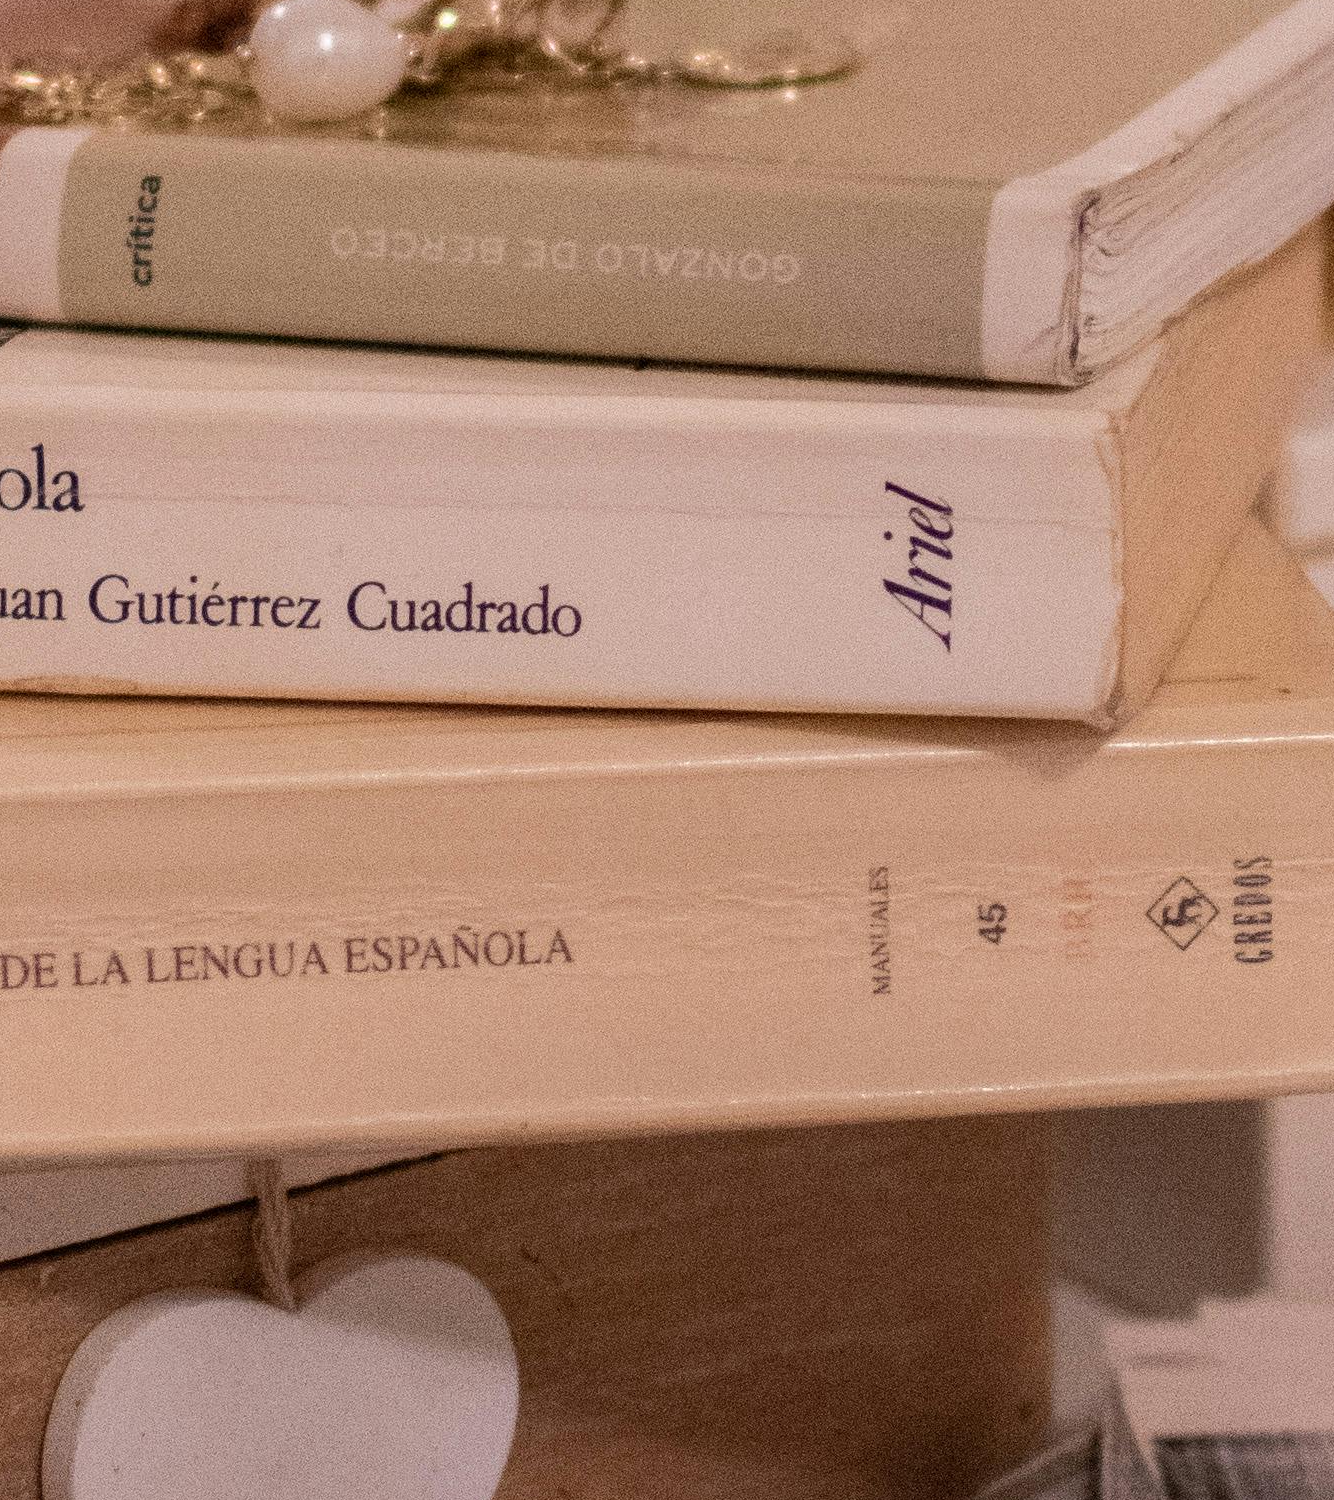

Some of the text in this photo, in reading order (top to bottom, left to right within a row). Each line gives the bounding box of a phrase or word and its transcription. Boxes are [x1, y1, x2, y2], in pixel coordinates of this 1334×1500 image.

[127, 176, 161, 287] crítica
[331, 226, 800, 283] GONZALO DE BERCEO
[88, 574, 320, 629] Gutiérrez
[347, 581, 582, 637] Cuadrado
[883, 482, 953, 649] Ariel
[869, 866, 890, 995] MANUALES
[978, 902, 1006, 944] 45
[1233, 857, 1272, 964] GREDOS
[0, 953, 57, 990] DE
[73, 952, 130, 987] LA
[146, 942, 328, 983] LENGUA
[344, 926, 573, 973] ESPAÑOLA
